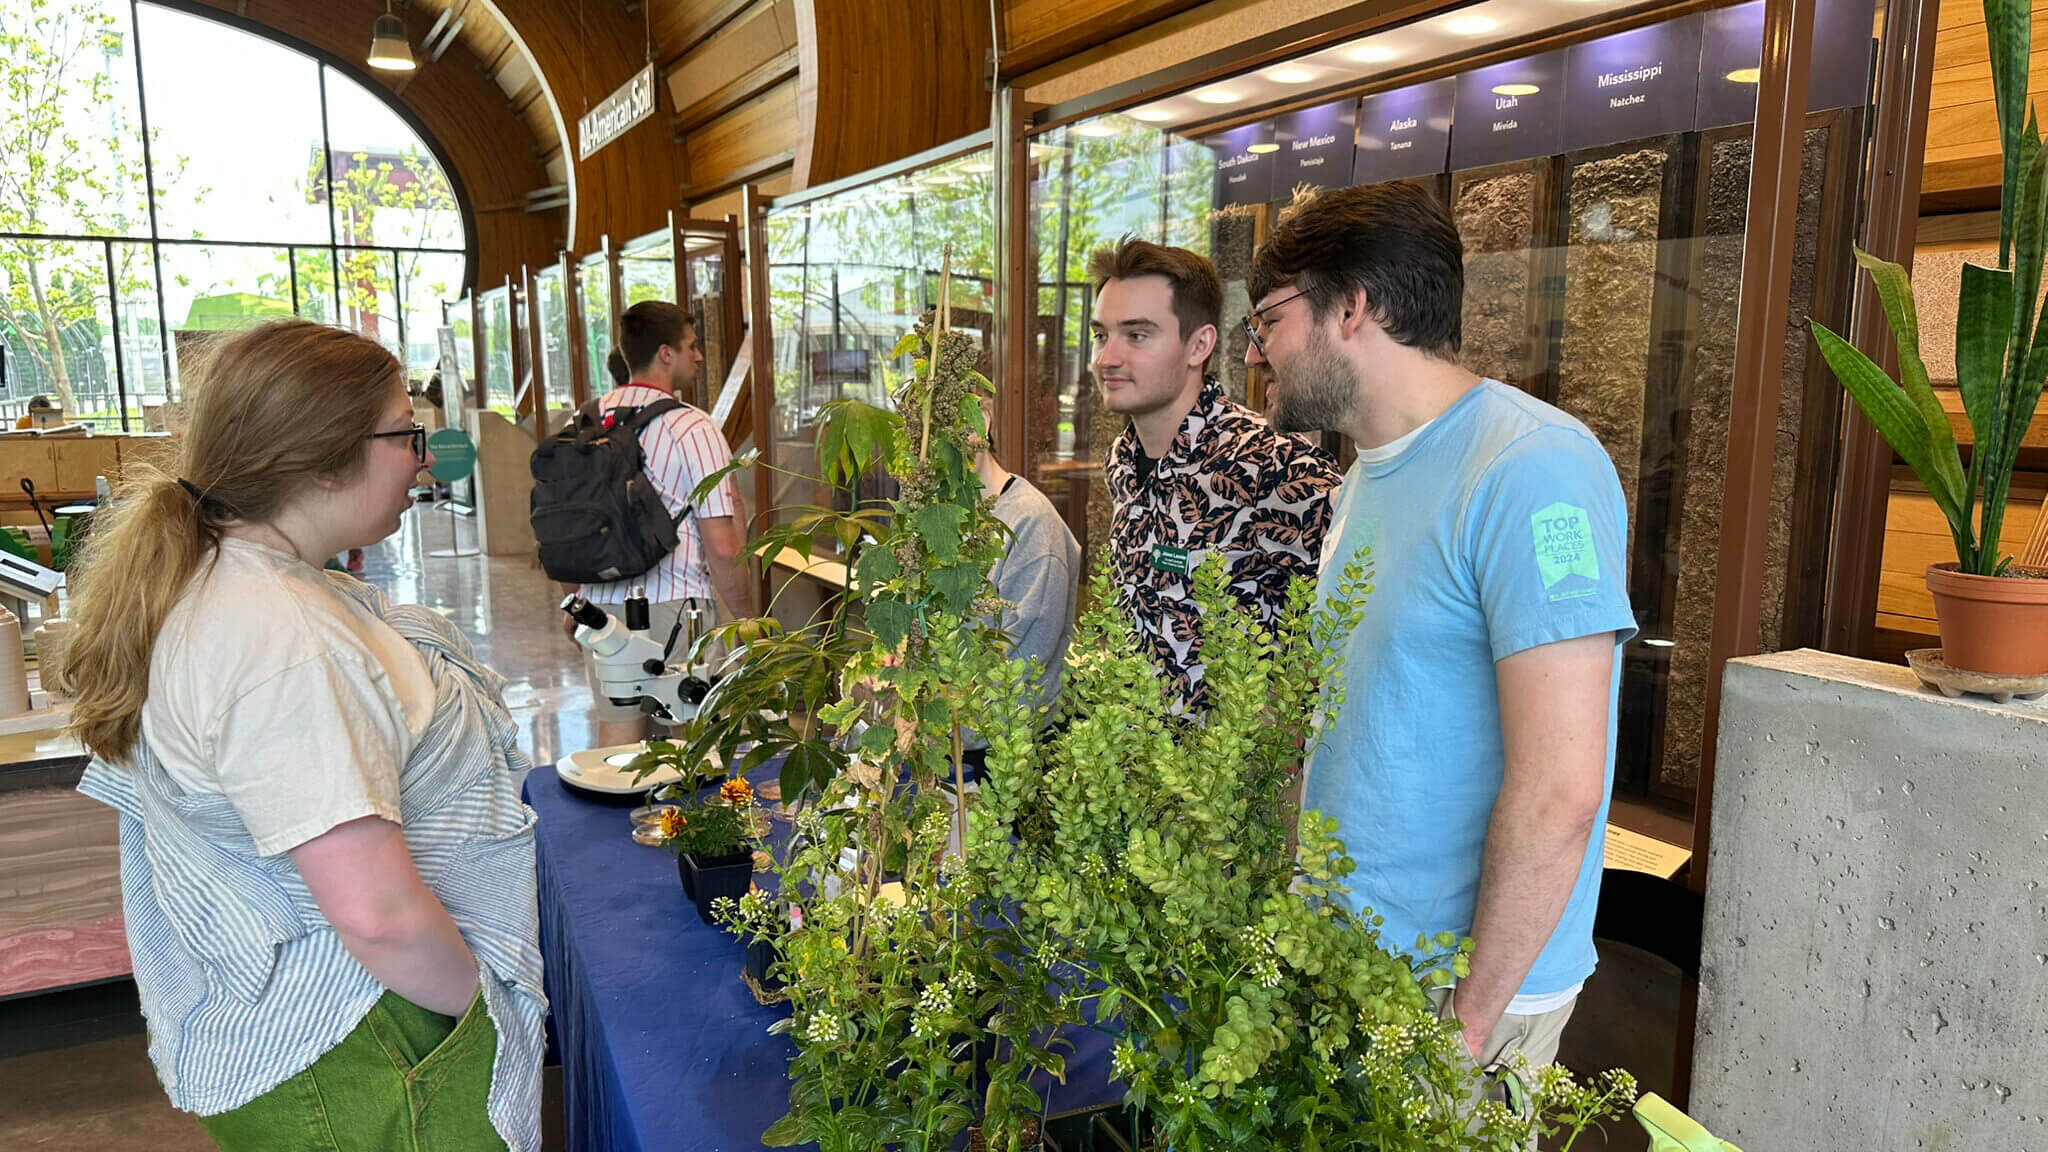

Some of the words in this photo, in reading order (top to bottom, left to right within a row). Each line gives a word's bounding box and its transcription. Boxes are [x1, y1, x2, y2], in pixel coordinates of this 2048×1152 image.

[1598, 61, 1663, 88] Mississippi
[1495, 95, 1518, 110] Utah
[1610, 94, 1646, 109] Natchez
[579, 97, 632, 154] All-American
[632, 71, 651, 120] Soil
[1390, 117, 1418, 132] Alaska
[1492, 120, 1518, 132] Mivida
[1292, 140, 1308, 152] New
[1309, 133, 1336, 149] Mexico
[1390, 140, 1412, 151] Tanana
[1218, 158, 1236, 170] South
[1237, 153, 1259, 166] Dakota
[1541, 516, 1579, 533] TOP
[1543, 529, 1583, 544] WORK
[1544, 541, 1585, 554] PLACES
[1553, 552, 1581, 565] 2024
